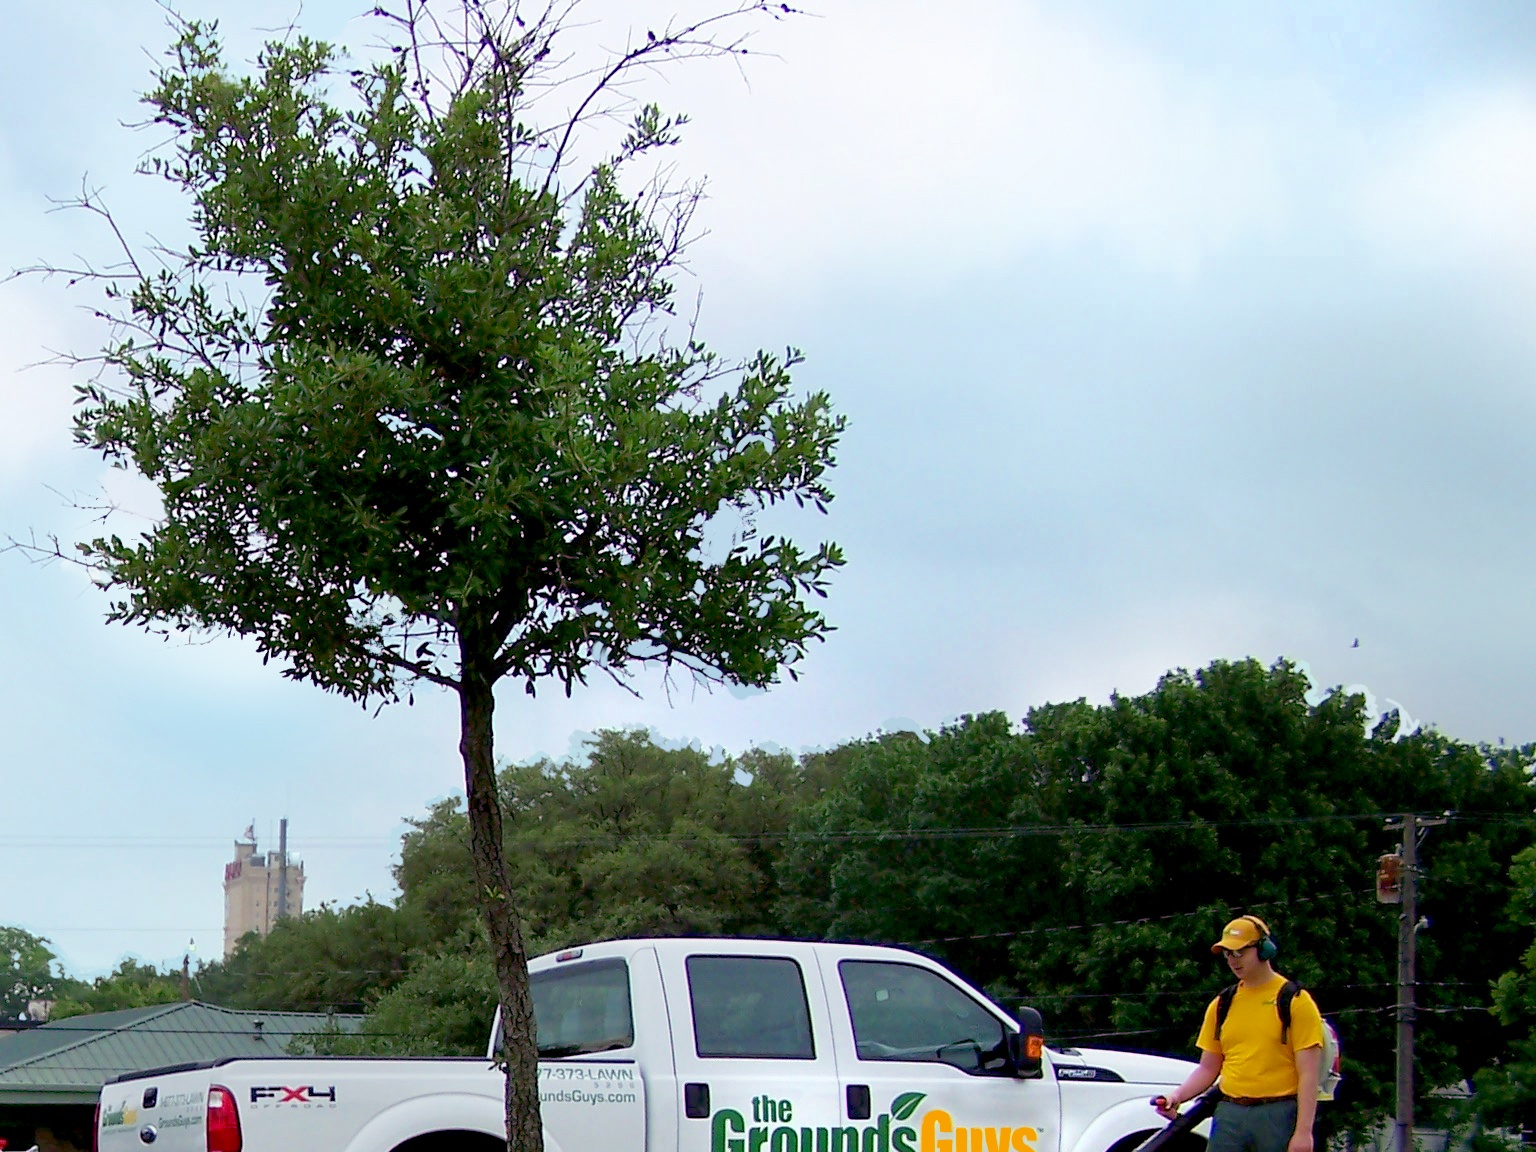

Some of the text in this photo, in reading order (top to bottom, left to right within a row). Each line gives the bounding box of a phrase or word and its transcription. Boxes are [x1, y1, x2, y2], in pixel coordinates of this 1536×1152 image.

[250, 1085, 336, 1102] FX4
[539, 1090, 636, 1106] undsGuys.com
[752, 1094, 792, 1123] the
